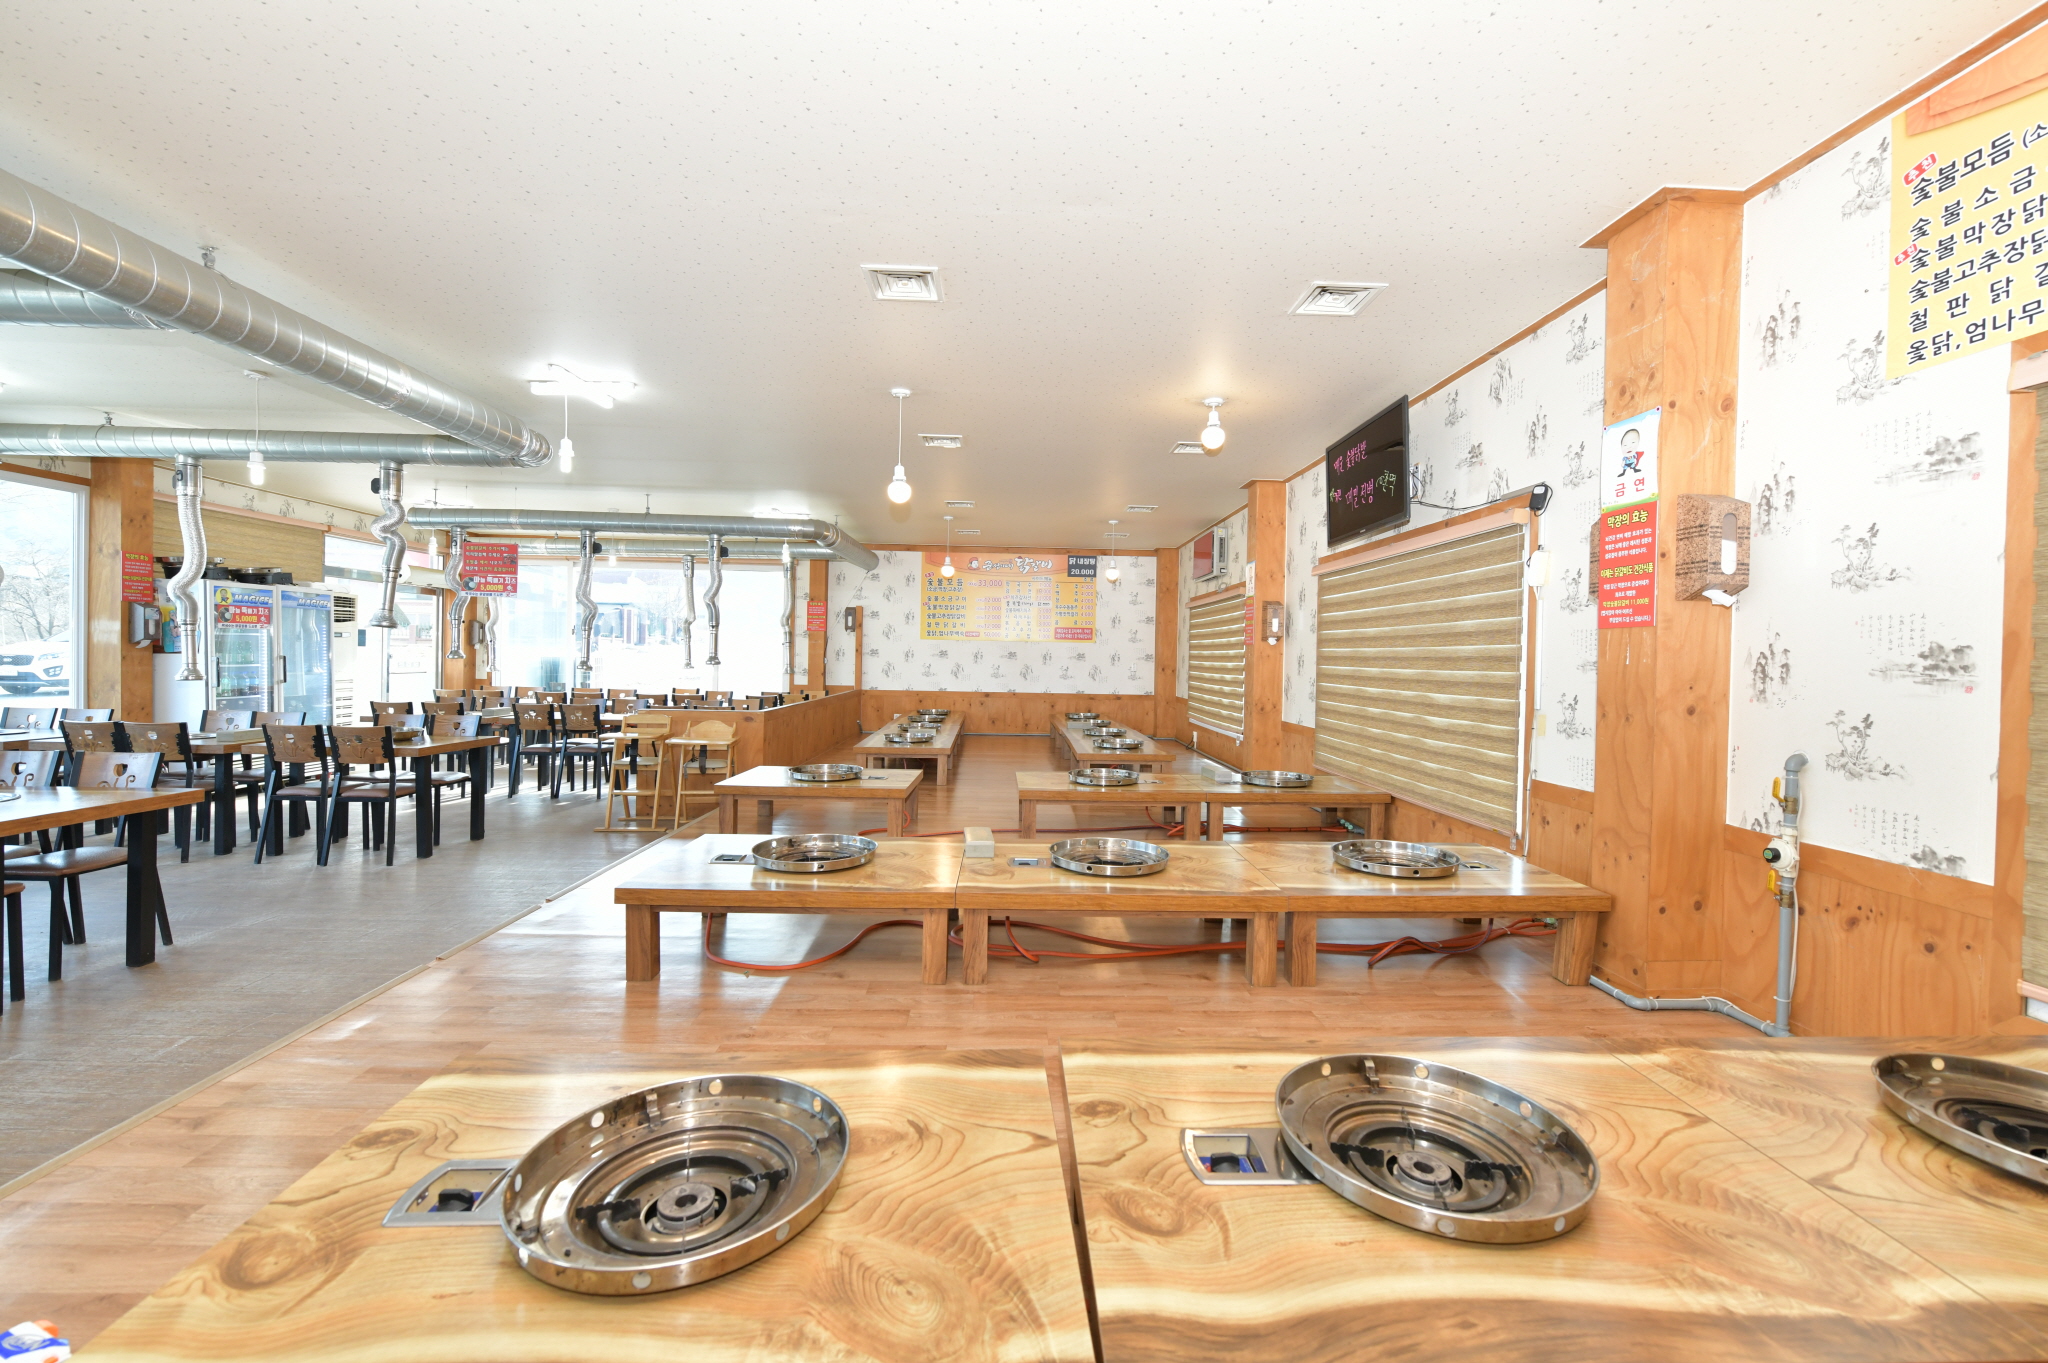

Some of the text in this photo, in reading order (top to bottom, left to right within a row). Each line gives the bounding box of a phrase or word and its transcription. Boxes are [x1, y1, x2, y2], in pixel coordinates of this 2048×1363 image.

[1607, 509, 1649, 529] 막장의 효능
[1014, 556, 1053, 574] 닭갈비
[1614, 565, 1633, 578] 닭갈비도
[1634, 562, 1654, 575] 건강식품
[480, 584, 504, 592] 5,000원
